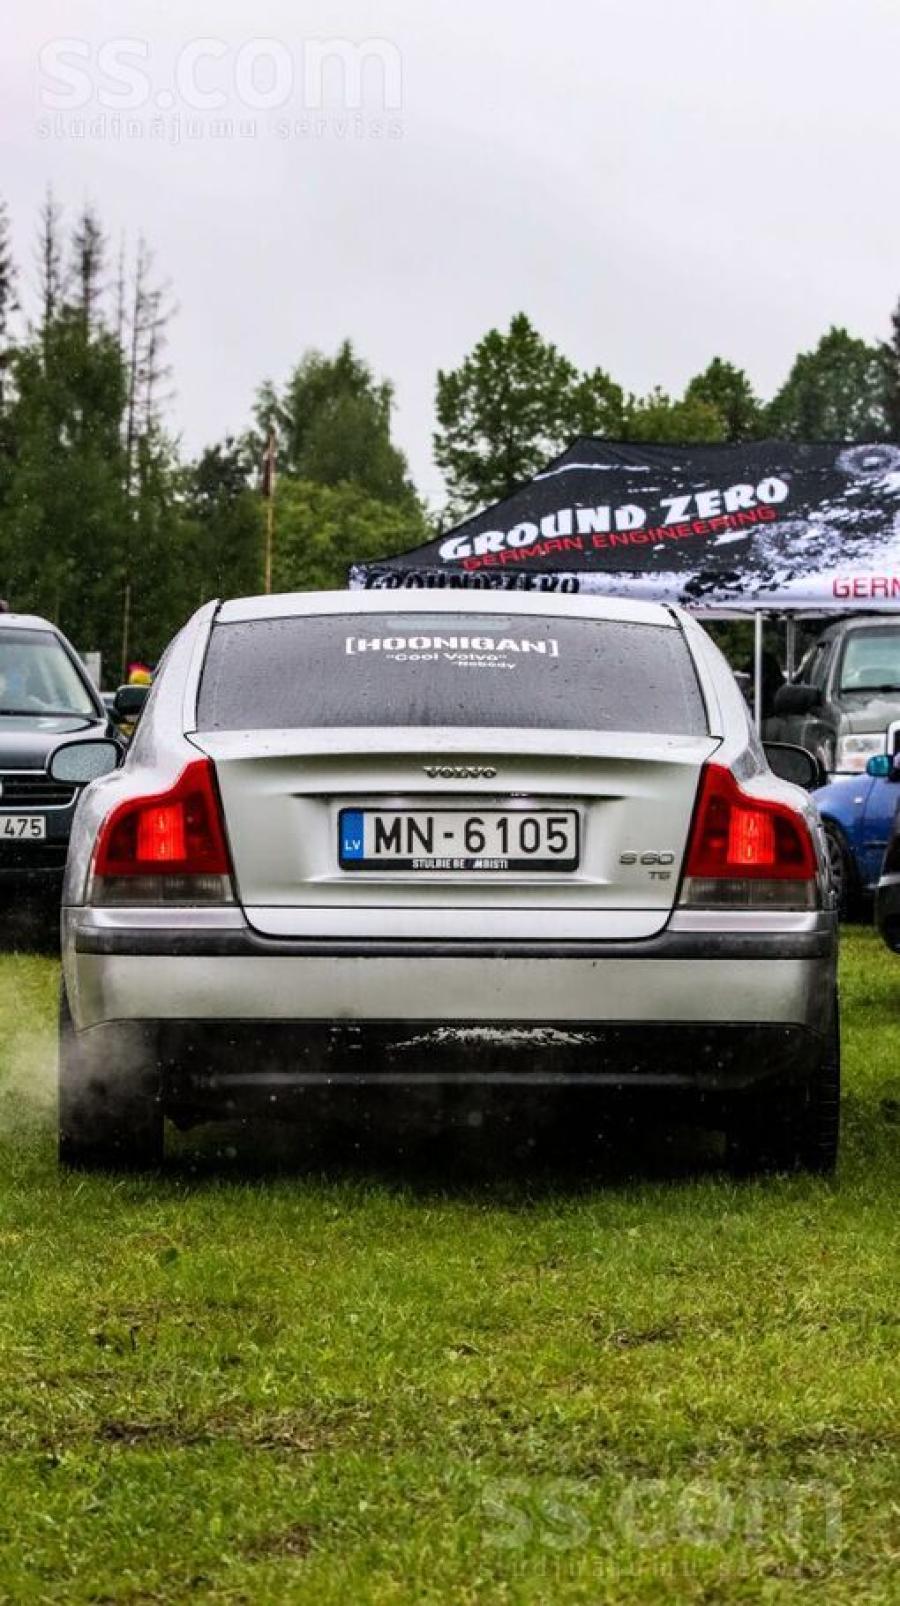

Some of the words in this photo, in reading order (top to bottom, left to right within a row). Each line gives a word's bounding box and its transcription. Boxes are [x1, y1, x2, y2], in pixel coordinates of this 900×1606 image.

[439, 504, 647, 560] GROUND
[660, 476, 788, 526] ZERO
[463, 537, 583, 571] GERMAN
[592, 505, 777, 548] ENGINEERING
[423, 766, 497, 778] VOLVO
[4, 818, 42, 836] 475
[345, 840, 361, 850] LV
